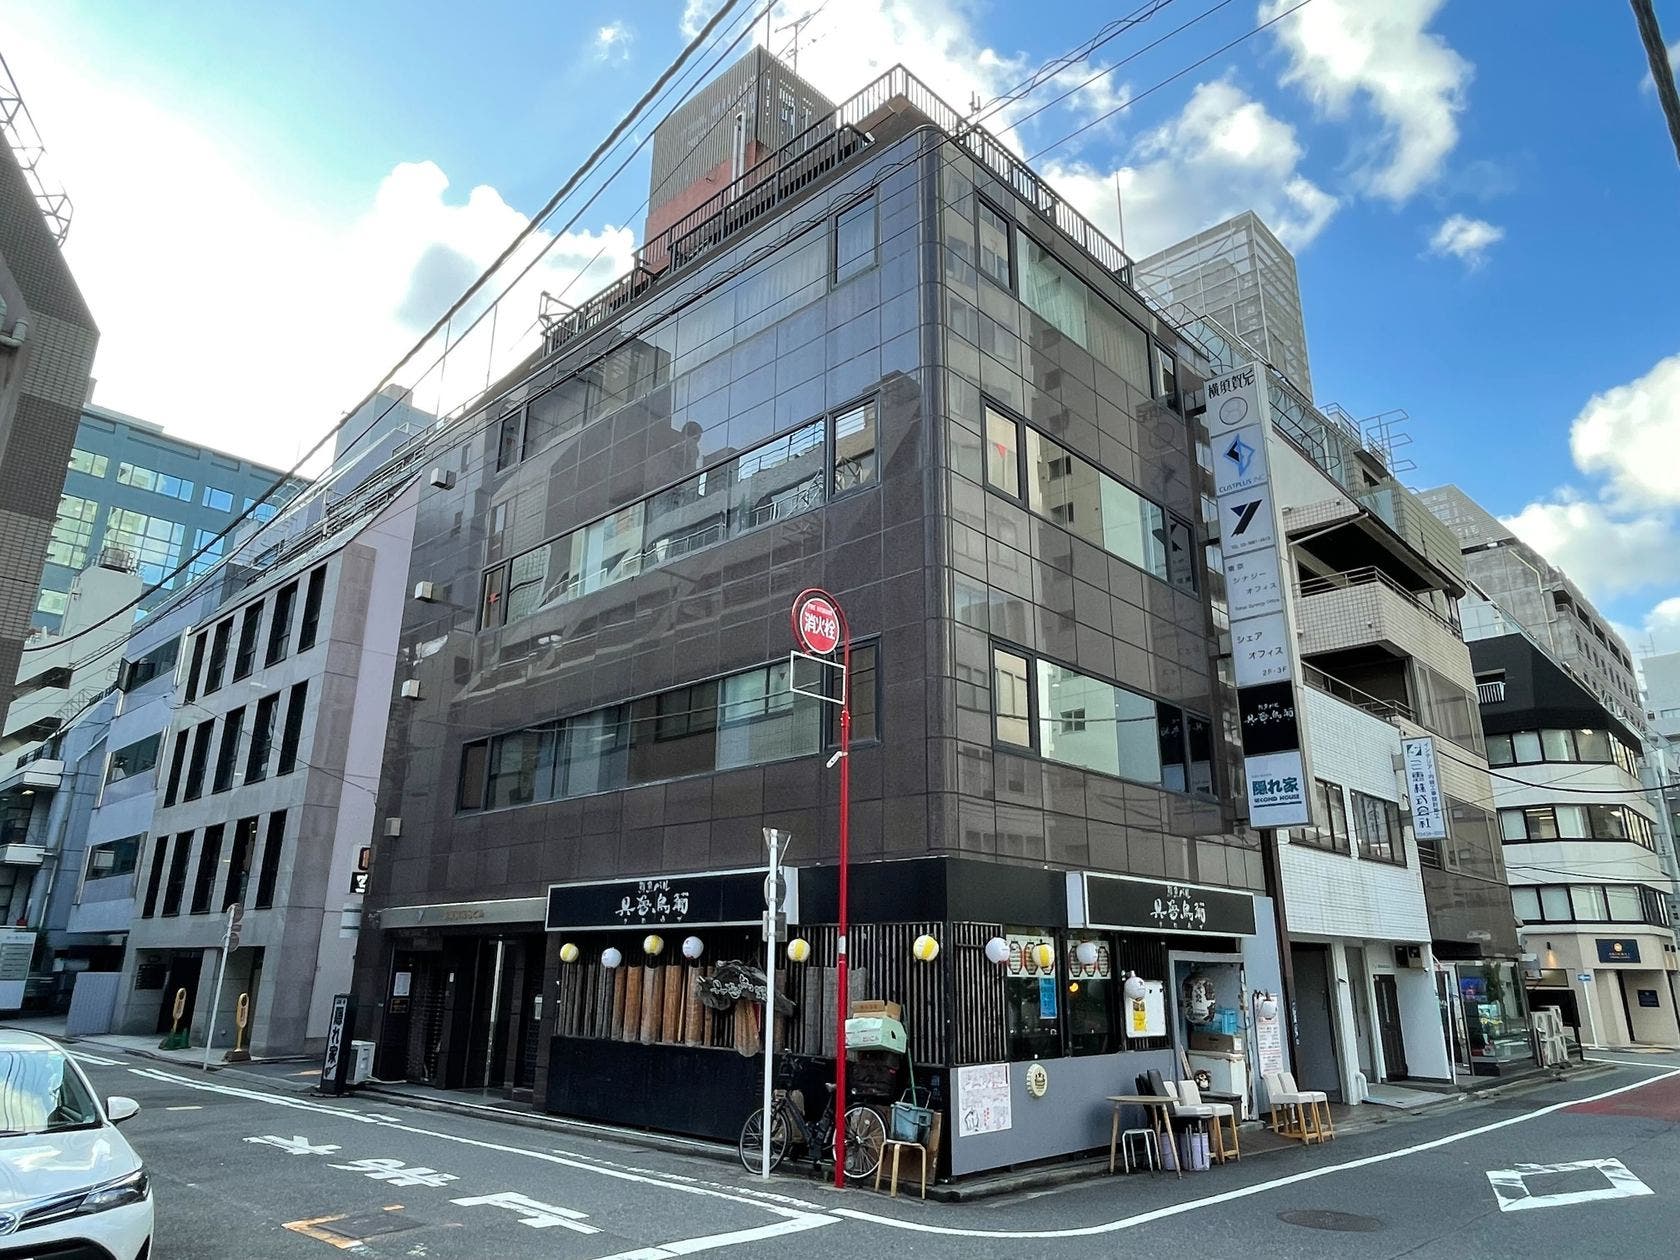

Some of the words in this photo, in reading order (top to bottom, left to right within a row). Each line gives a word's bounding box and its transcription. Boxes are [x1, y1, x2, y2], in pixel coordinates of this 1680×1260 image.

[1233, 571, 1266, 584] シナジー
[1247, 582, 1277, 595] オフィス
[804, 611, 836, 640] 消火栓
[1237, 631, 1263, 644] シェア
[1248, 646, 1283, 660] オフィス
[1252, 776, 1299, 796] 隠れ家
